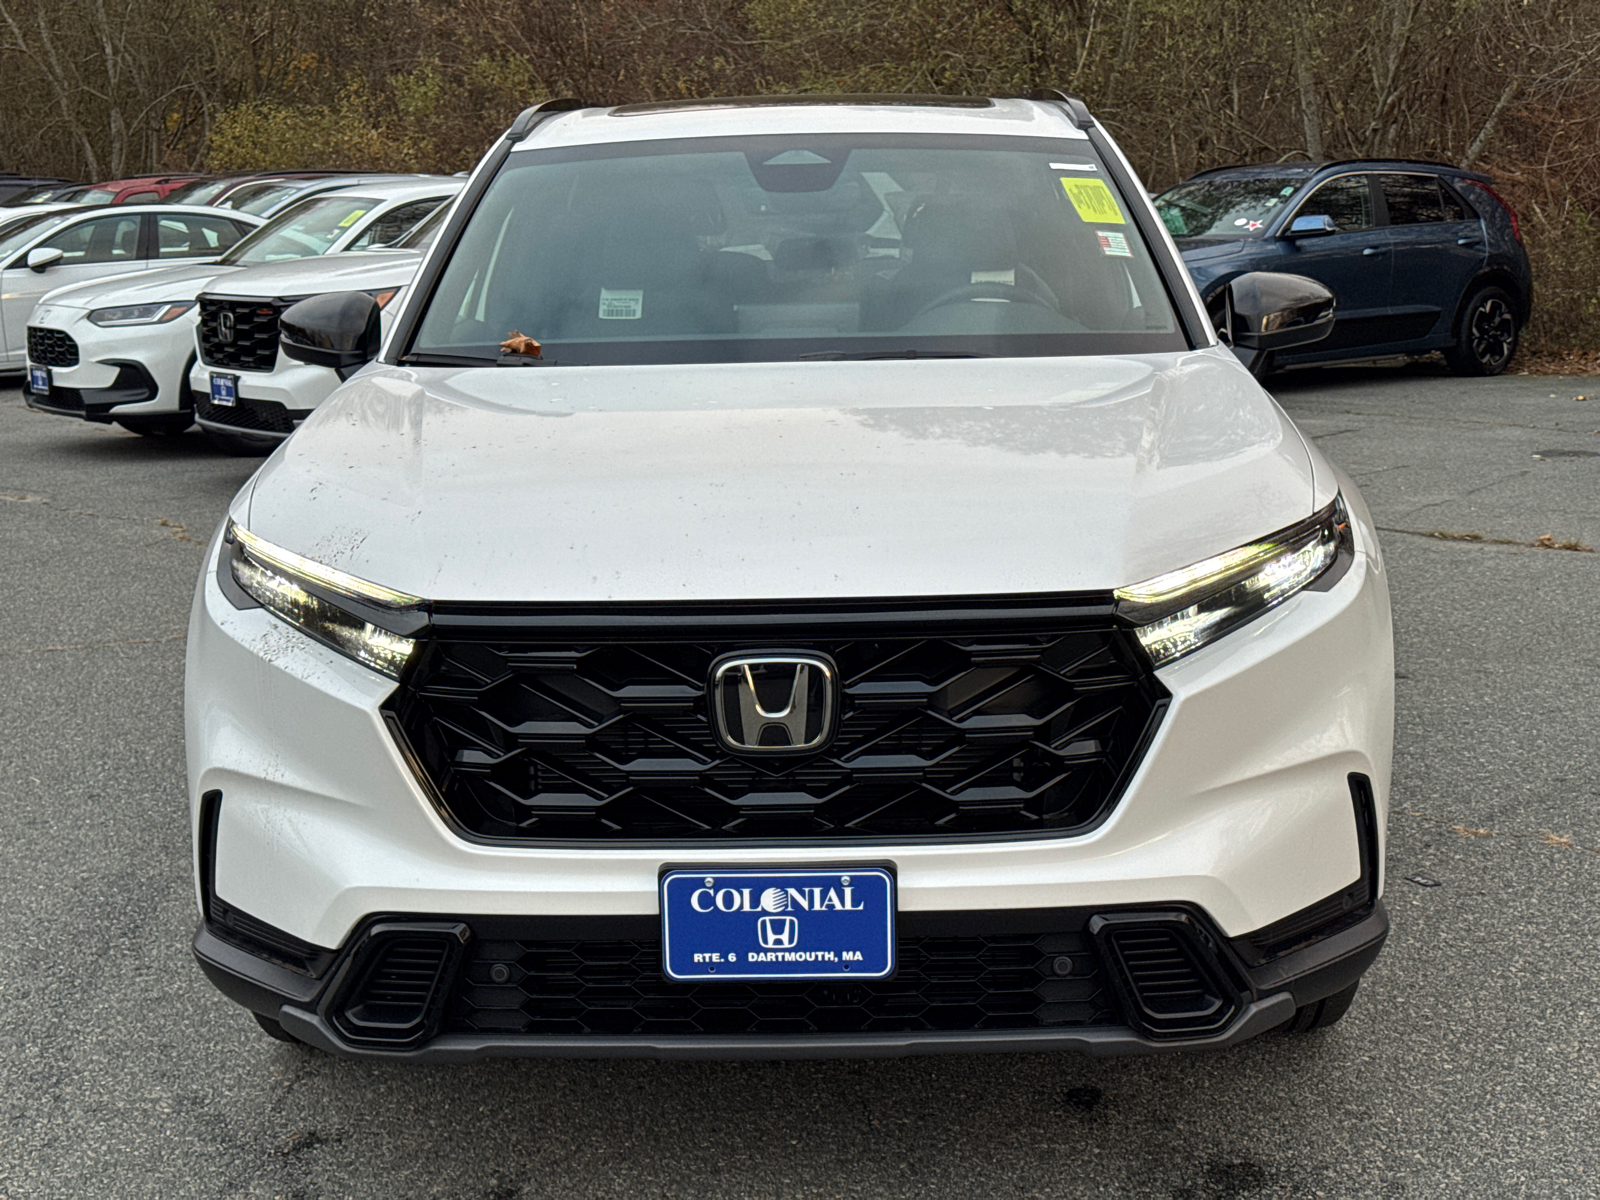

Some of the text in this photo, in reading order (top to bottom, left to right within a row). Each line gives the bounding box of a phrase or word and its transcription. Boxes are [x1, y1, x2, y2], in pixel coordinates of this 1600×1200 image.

[690, 887, 864, 913] COLONIAL
[693, 951, 863, 964] RTE. 6 DARTMOUTH, MA
